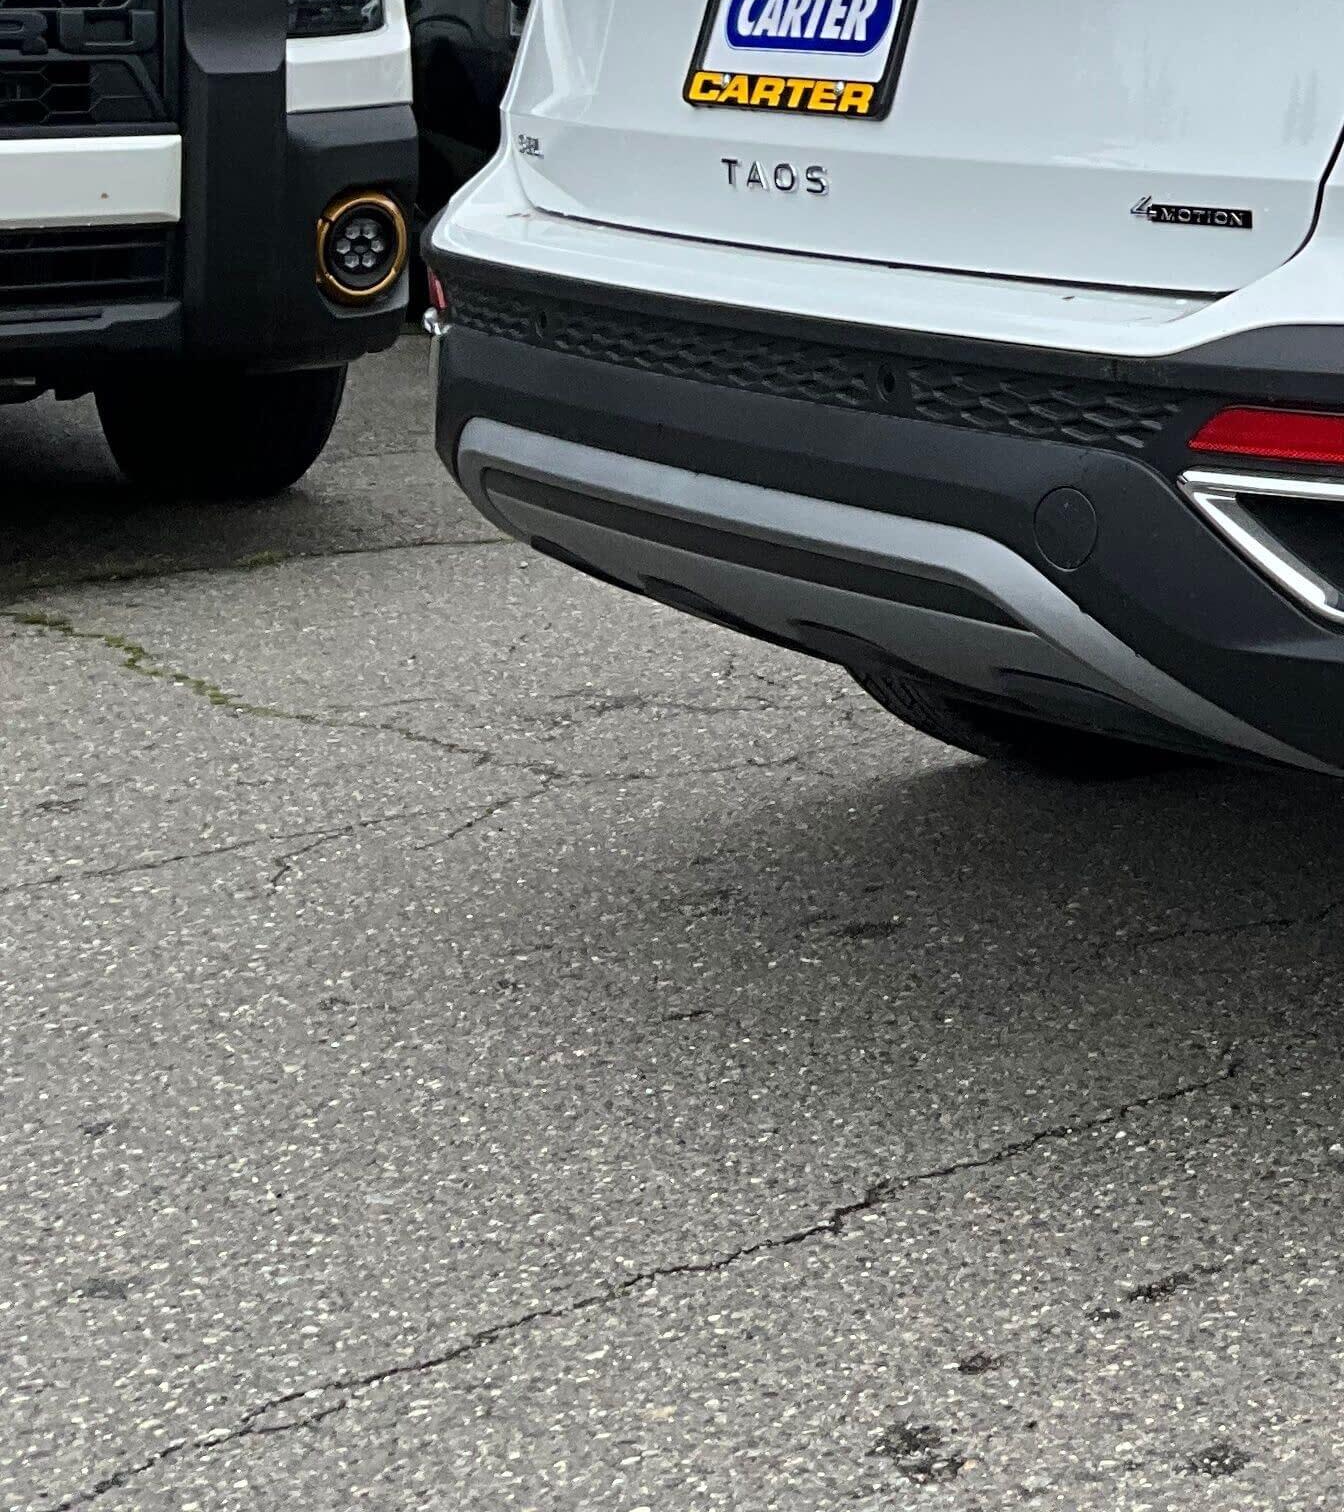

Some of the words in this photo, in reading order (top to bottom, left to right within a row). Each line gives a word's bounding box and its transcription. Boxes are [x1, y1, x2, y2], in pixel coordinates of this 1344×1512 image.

[689, 71, 874, 114] CARTER
[721, 157, 830, 196] TAOS
[1130, 195, 1245, 227] 4MOTION
